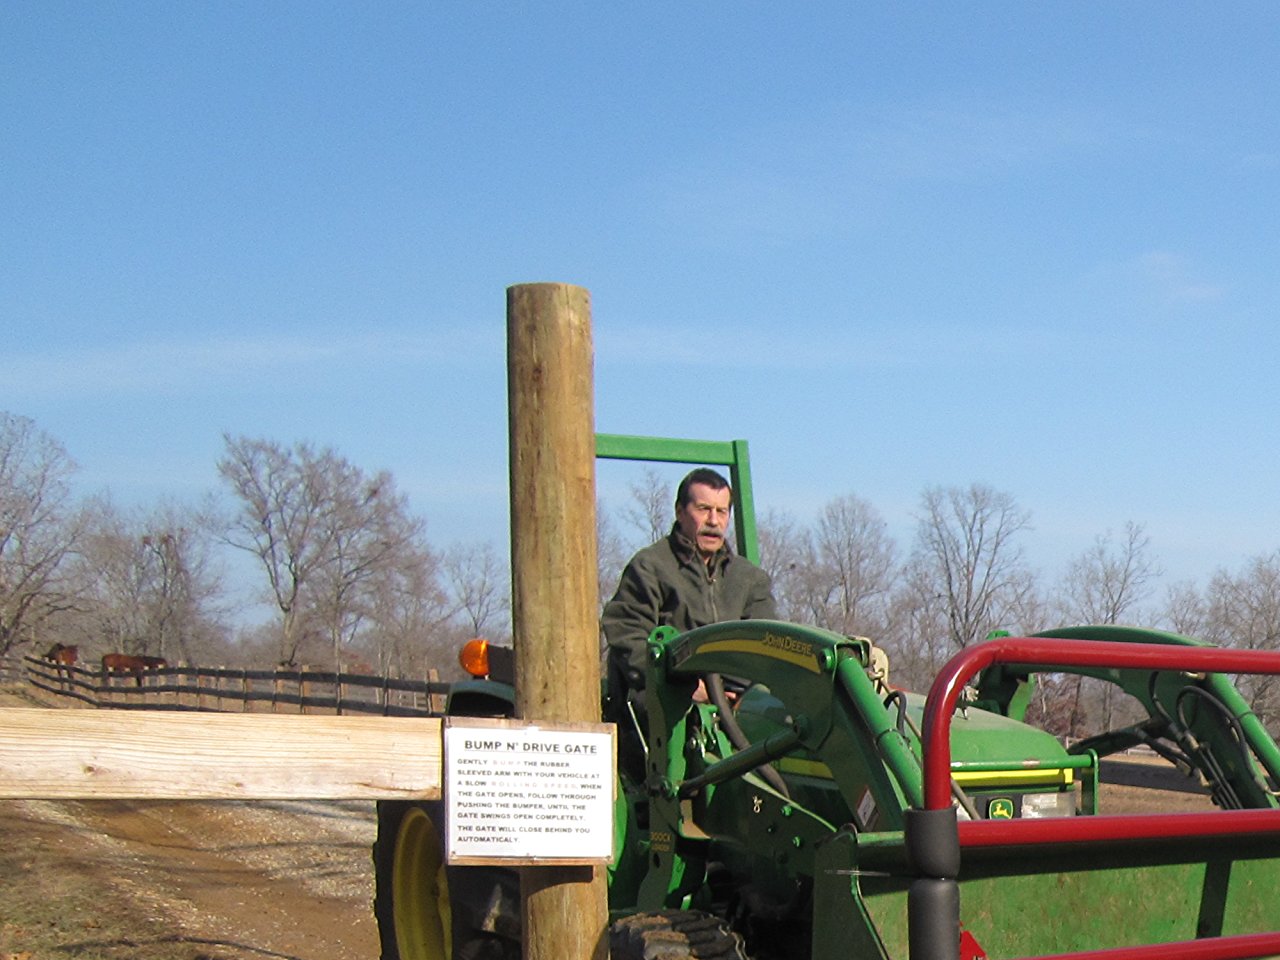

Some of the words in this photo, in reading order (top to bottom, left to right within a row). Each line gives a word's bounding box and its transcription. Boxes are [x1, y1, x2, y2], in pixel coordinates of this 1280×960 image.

[464, 740, 502, 750] BUMP
[523, 743, 560, 753] DRIVE
[564, 744, 597, 754] GATE
